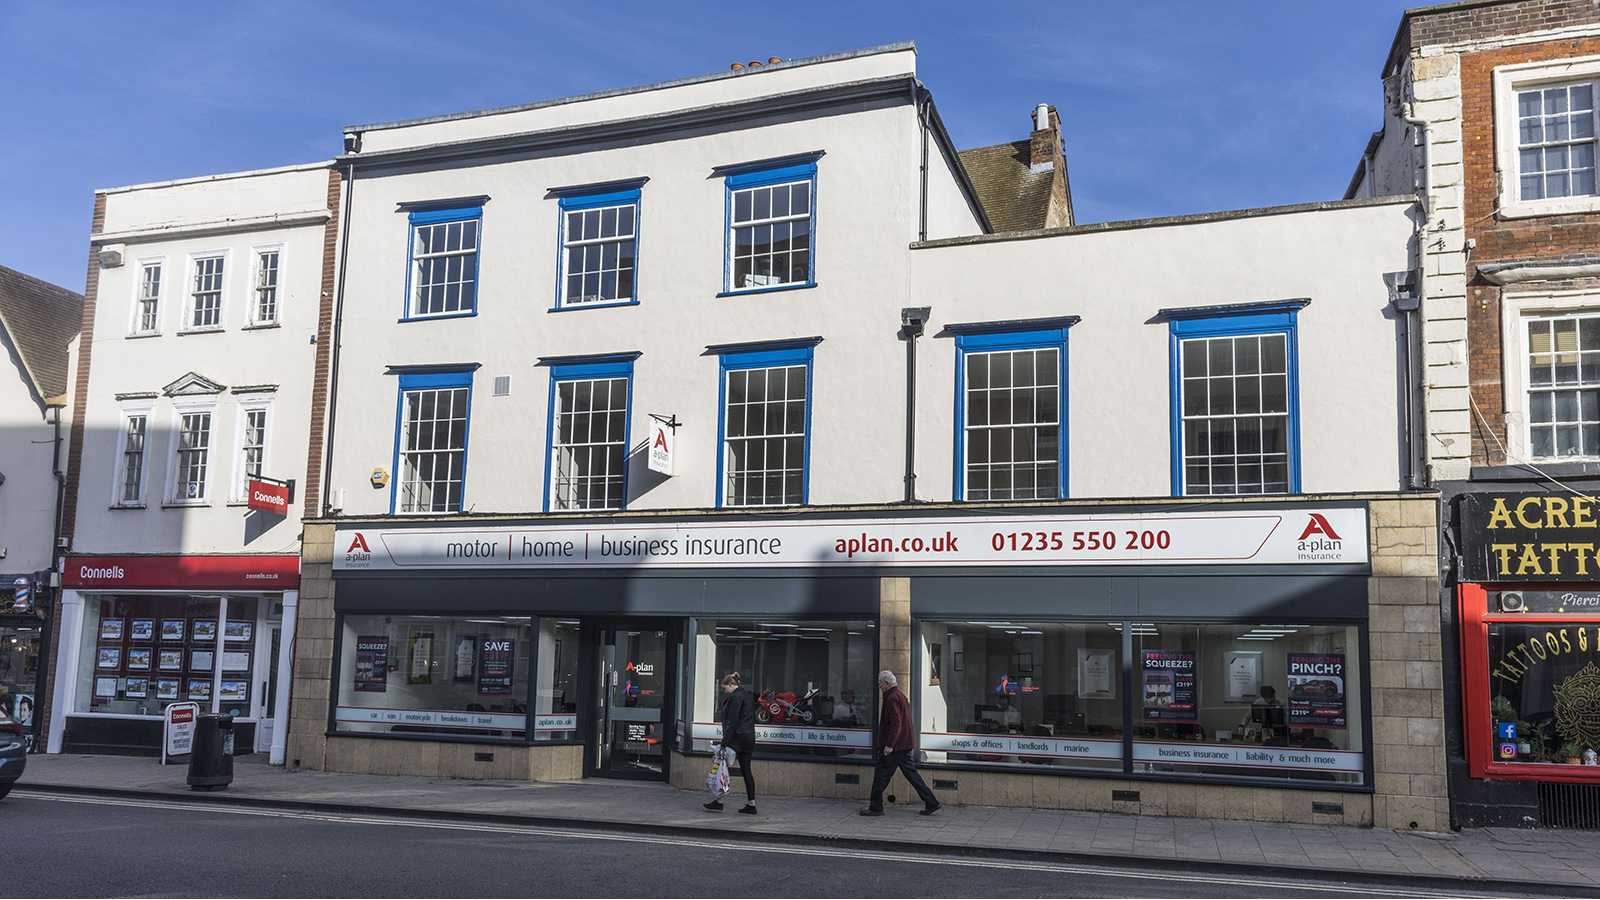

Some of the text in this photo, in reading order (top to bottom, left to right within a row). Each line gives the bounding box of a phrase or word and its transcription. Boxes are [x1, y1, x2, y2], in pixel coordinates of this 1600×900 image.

[254, 490, 285, 506] Connells
[1486, 496, 1600, 529] ACRE
[447, 534, 781, 558] motor home business insurance
[835, 531, 959, 558] aplan.co.uk
[992, 530, 1171, 552] 01235 550 200
[1298, 539, 1341, 553] a-plan
[346, 552, 371, 562] a-plan
[1298, 553, 1341, 561] insurance
[1492, 543, 1600, 576] TATT
[80, 565, 124, 579] Connells
[484, 641, 510, 651] SAVE
[1492, 628, 1572, 684] TATTOOS
[1578, 627, 1588, 652] &
[626, 661, 654, 673] A-plan
[1146, 660, 1193, 668] SQUEEZE?
[1292, 663, 1342, 674] PINCH?
[405, 713, 432, 722] motorcycle
[441, 714, 468, 723] breakdown
[477, 716, 492, 724] travel
[538, 718, 573, 726] aplan.co.uk
[770, 731, 795, 739] contents
[826, 733, 847, 741] health
[951, 739, 970, 748] shops
[980, 741, 1003, 749] offices
[1017, 741, 1049, 751] landlords
[1064, 745, 1089, 753] marine
[1159, 748, 1335, 764] business insurance liability & much more
